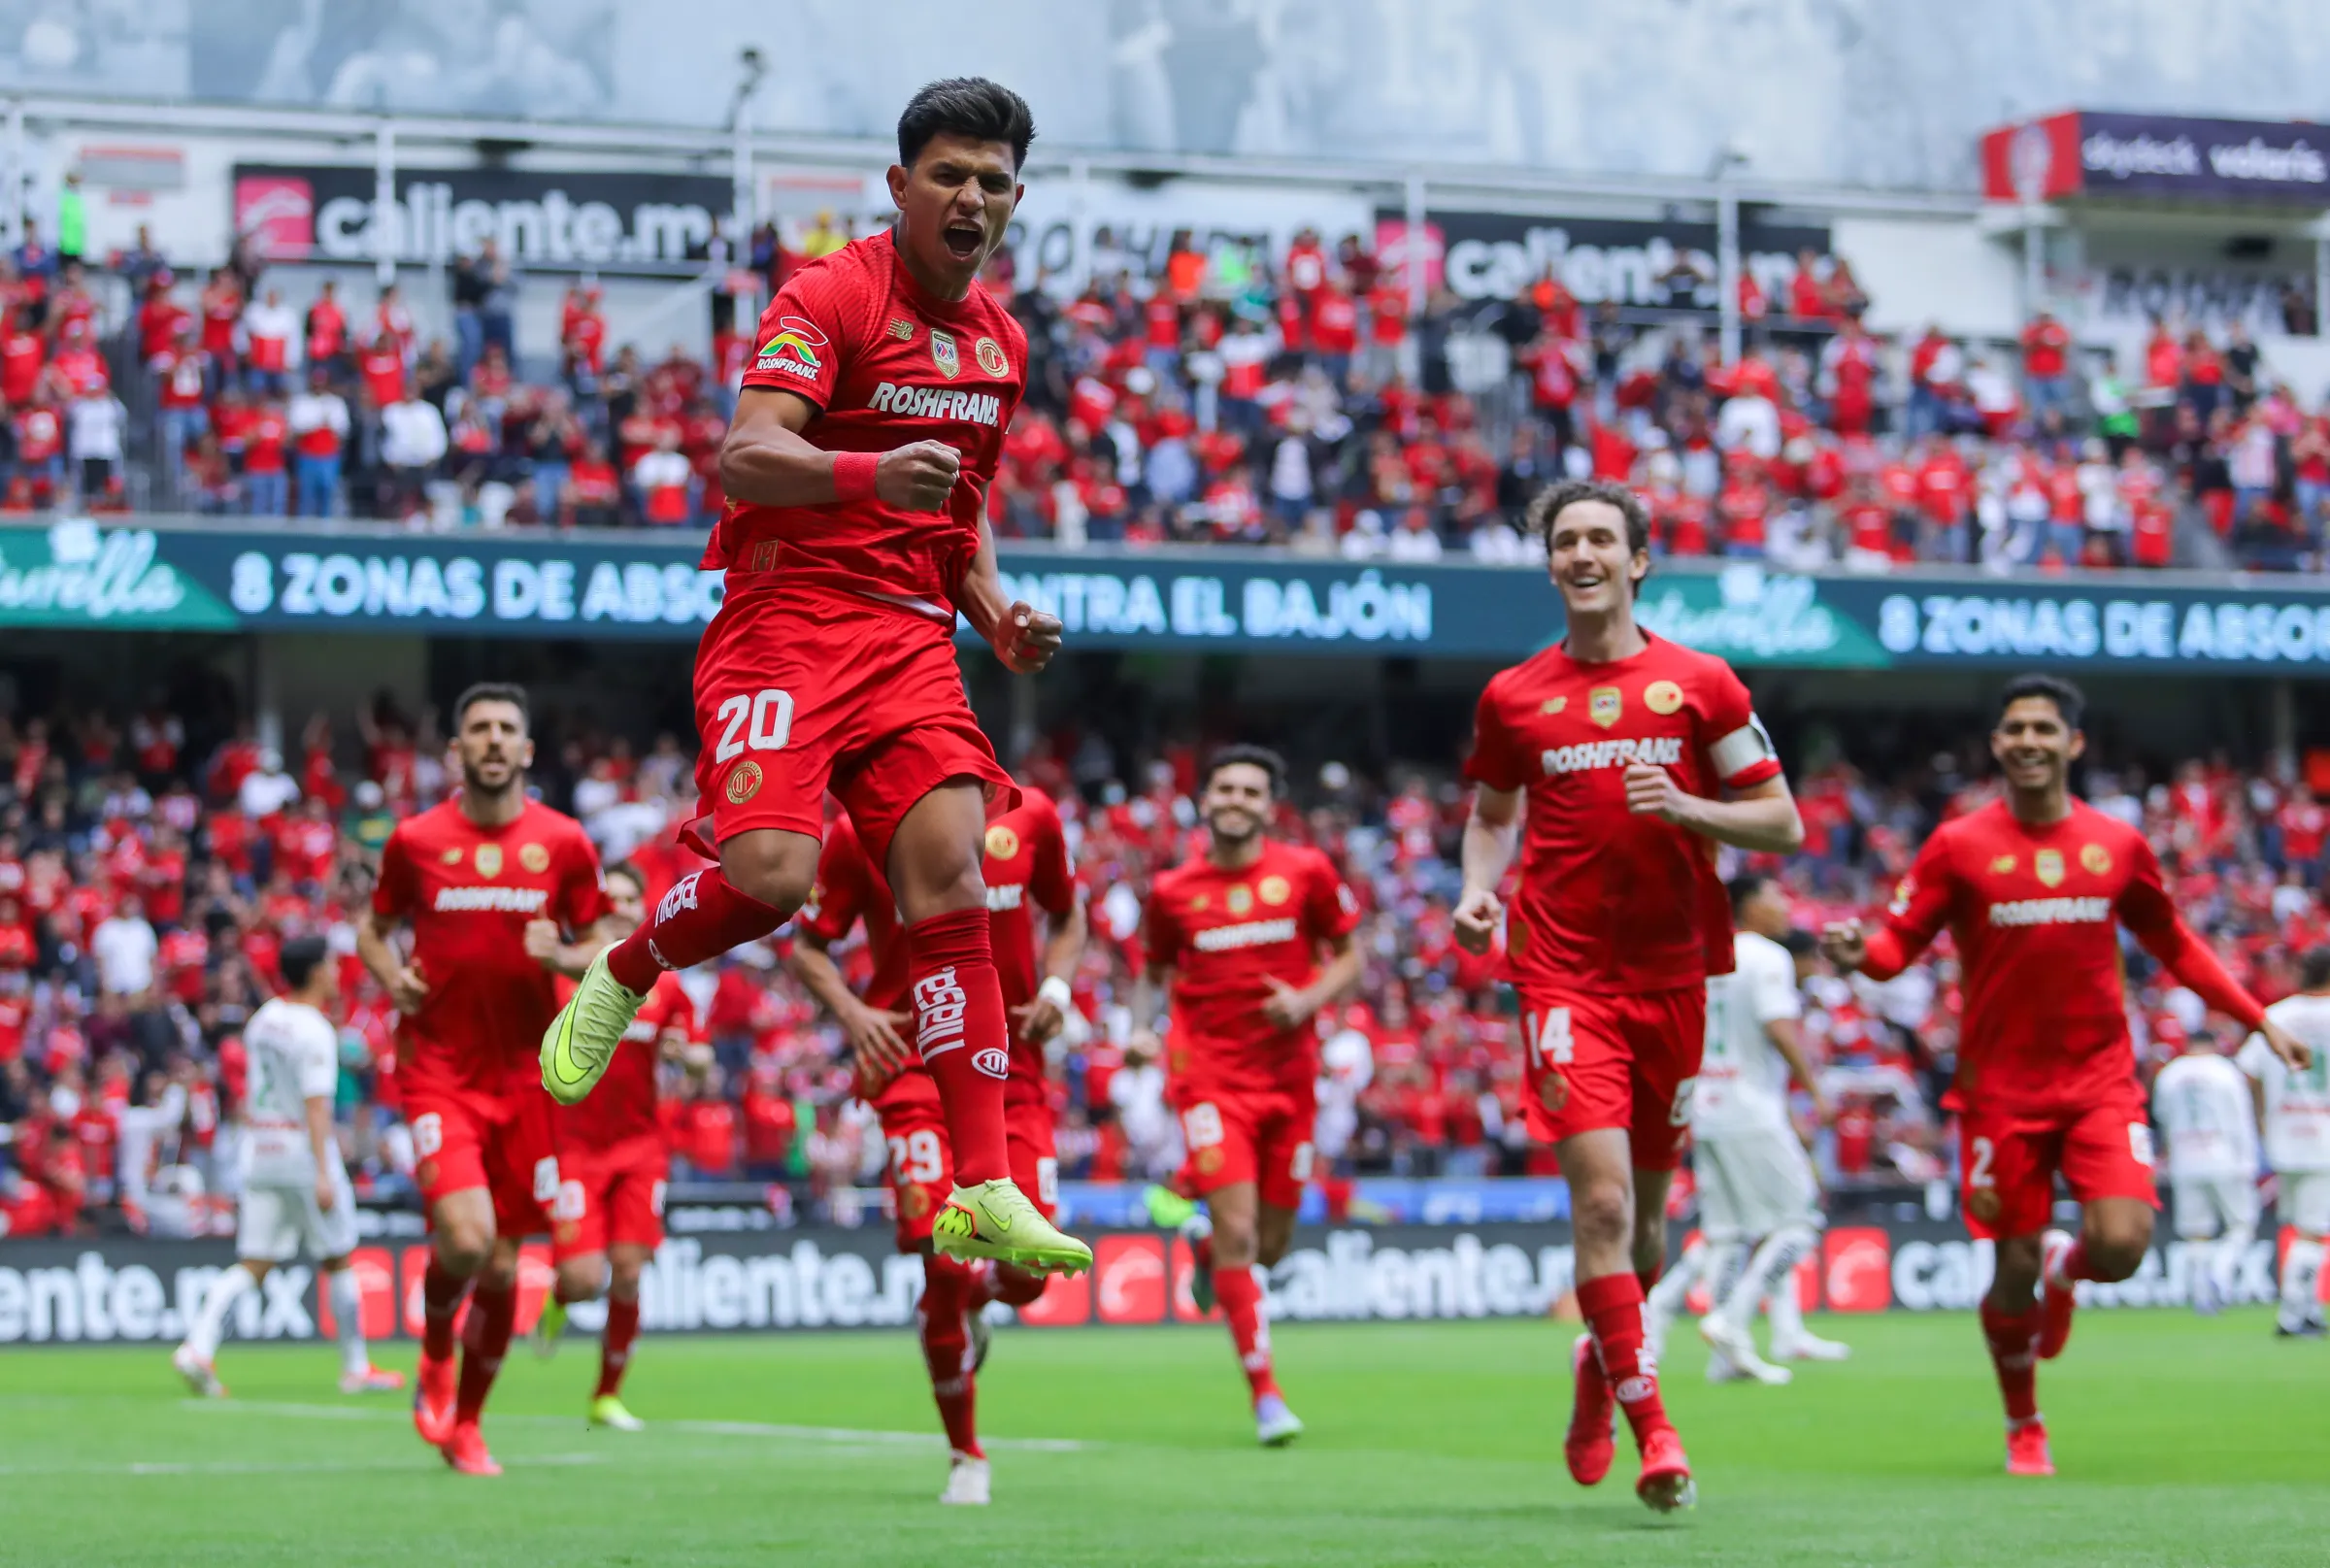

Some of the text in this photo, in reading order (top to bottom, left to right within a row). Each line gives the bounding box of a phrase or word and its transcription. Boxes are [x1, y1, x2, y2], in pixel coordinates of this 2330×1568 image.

[756, 357, 818, 382] ROSHFRANS
[867, 382, 1000, 427] ROSHFRANS
[230, 550, 728, 624] 8 ZONAS DE ABSO
[998, 568, 1432, 641] NTRA EL BAJÓN
[1878, 594, 1919, 653] 8
[1922, 595, 2099, 657] ZONAS
[2104, 599, 2175, 658] DE
[716, 688, 795, 764] 20
[1526, 1006, 1575, 1069] 14
[887, 1129, 944, 1185] 29
[1969, 1137, 1995, 1187] 2
